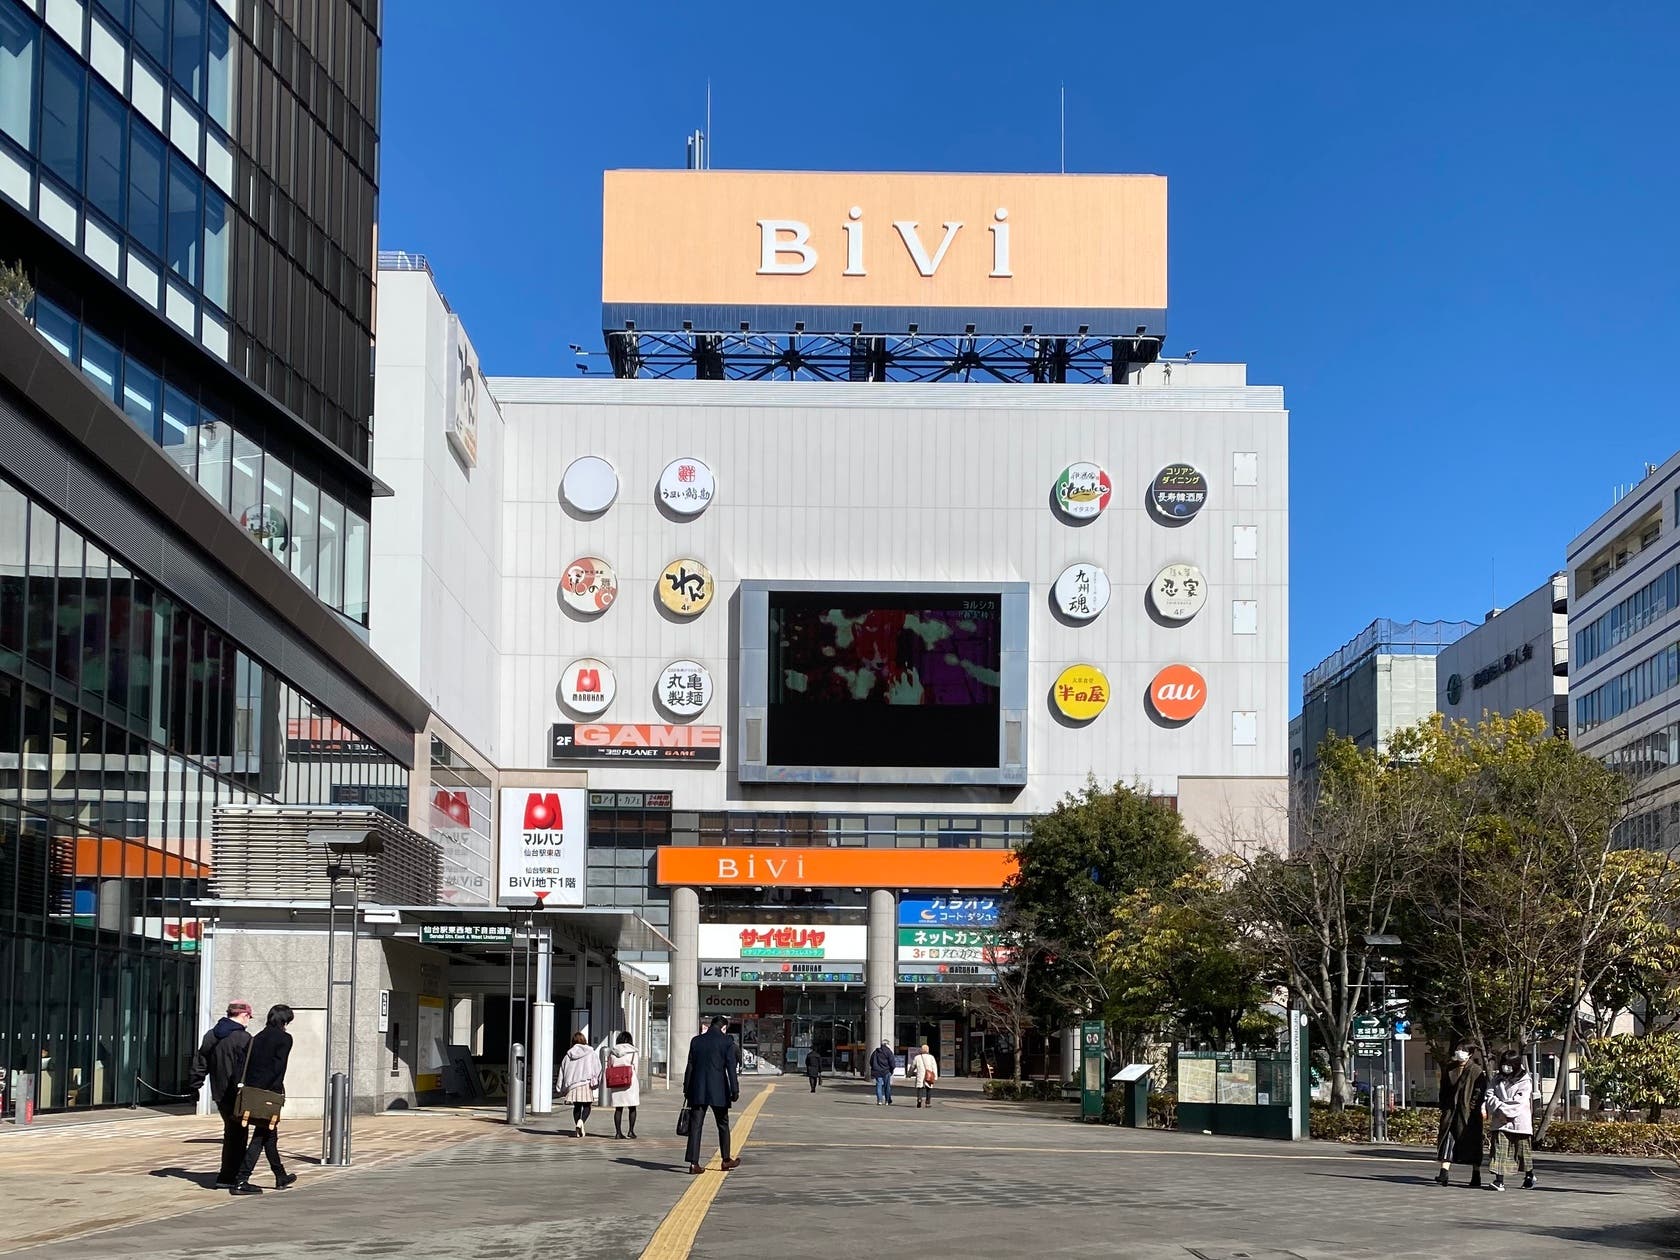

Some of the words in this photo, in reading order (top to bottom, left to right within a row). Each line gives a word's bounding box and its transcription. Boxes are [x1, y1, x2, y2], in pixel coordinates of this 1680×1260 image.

[756, 206, 1013, 279] BiVi
[1162, 476, 1200, 484] ダイニング
[663, 488, 710, 500] うまい鮨勘
[1158, 492, 1204, 502] 長寿韓酒房
[666, 567, 705, 601] わん
[1069, 569, 1090, 613] 九州魂
[963, 600, 995, 610] ヨルシカ
[667, 673, 703, 690] 丸亀
[572, 693, 604, 702] MARUHAN
[1059, 684, 1106, 702] 半田屋
[1157, 683, 1201, 700] au
[667, 691, 703, 706] 製麺
[556, 736, 572, 746] 2F
[575, 725, 721, 747] GAME
[523, 833, 563, 846] マルハン
[524, 849, 561, 857] 仙台駅東店
[525, 867, 560, 875] 仙台駅東口
[718, 854, 805, 879] BiVi
[509, 877, 576, 889] BiVi地下1階
[931, 897, 995, 909] カラオケ
[739, 927, 826, 948] サイゼリヤ
[913, 949, 926, 958] 3F
[714, 967, 740, 977] 地下1F
